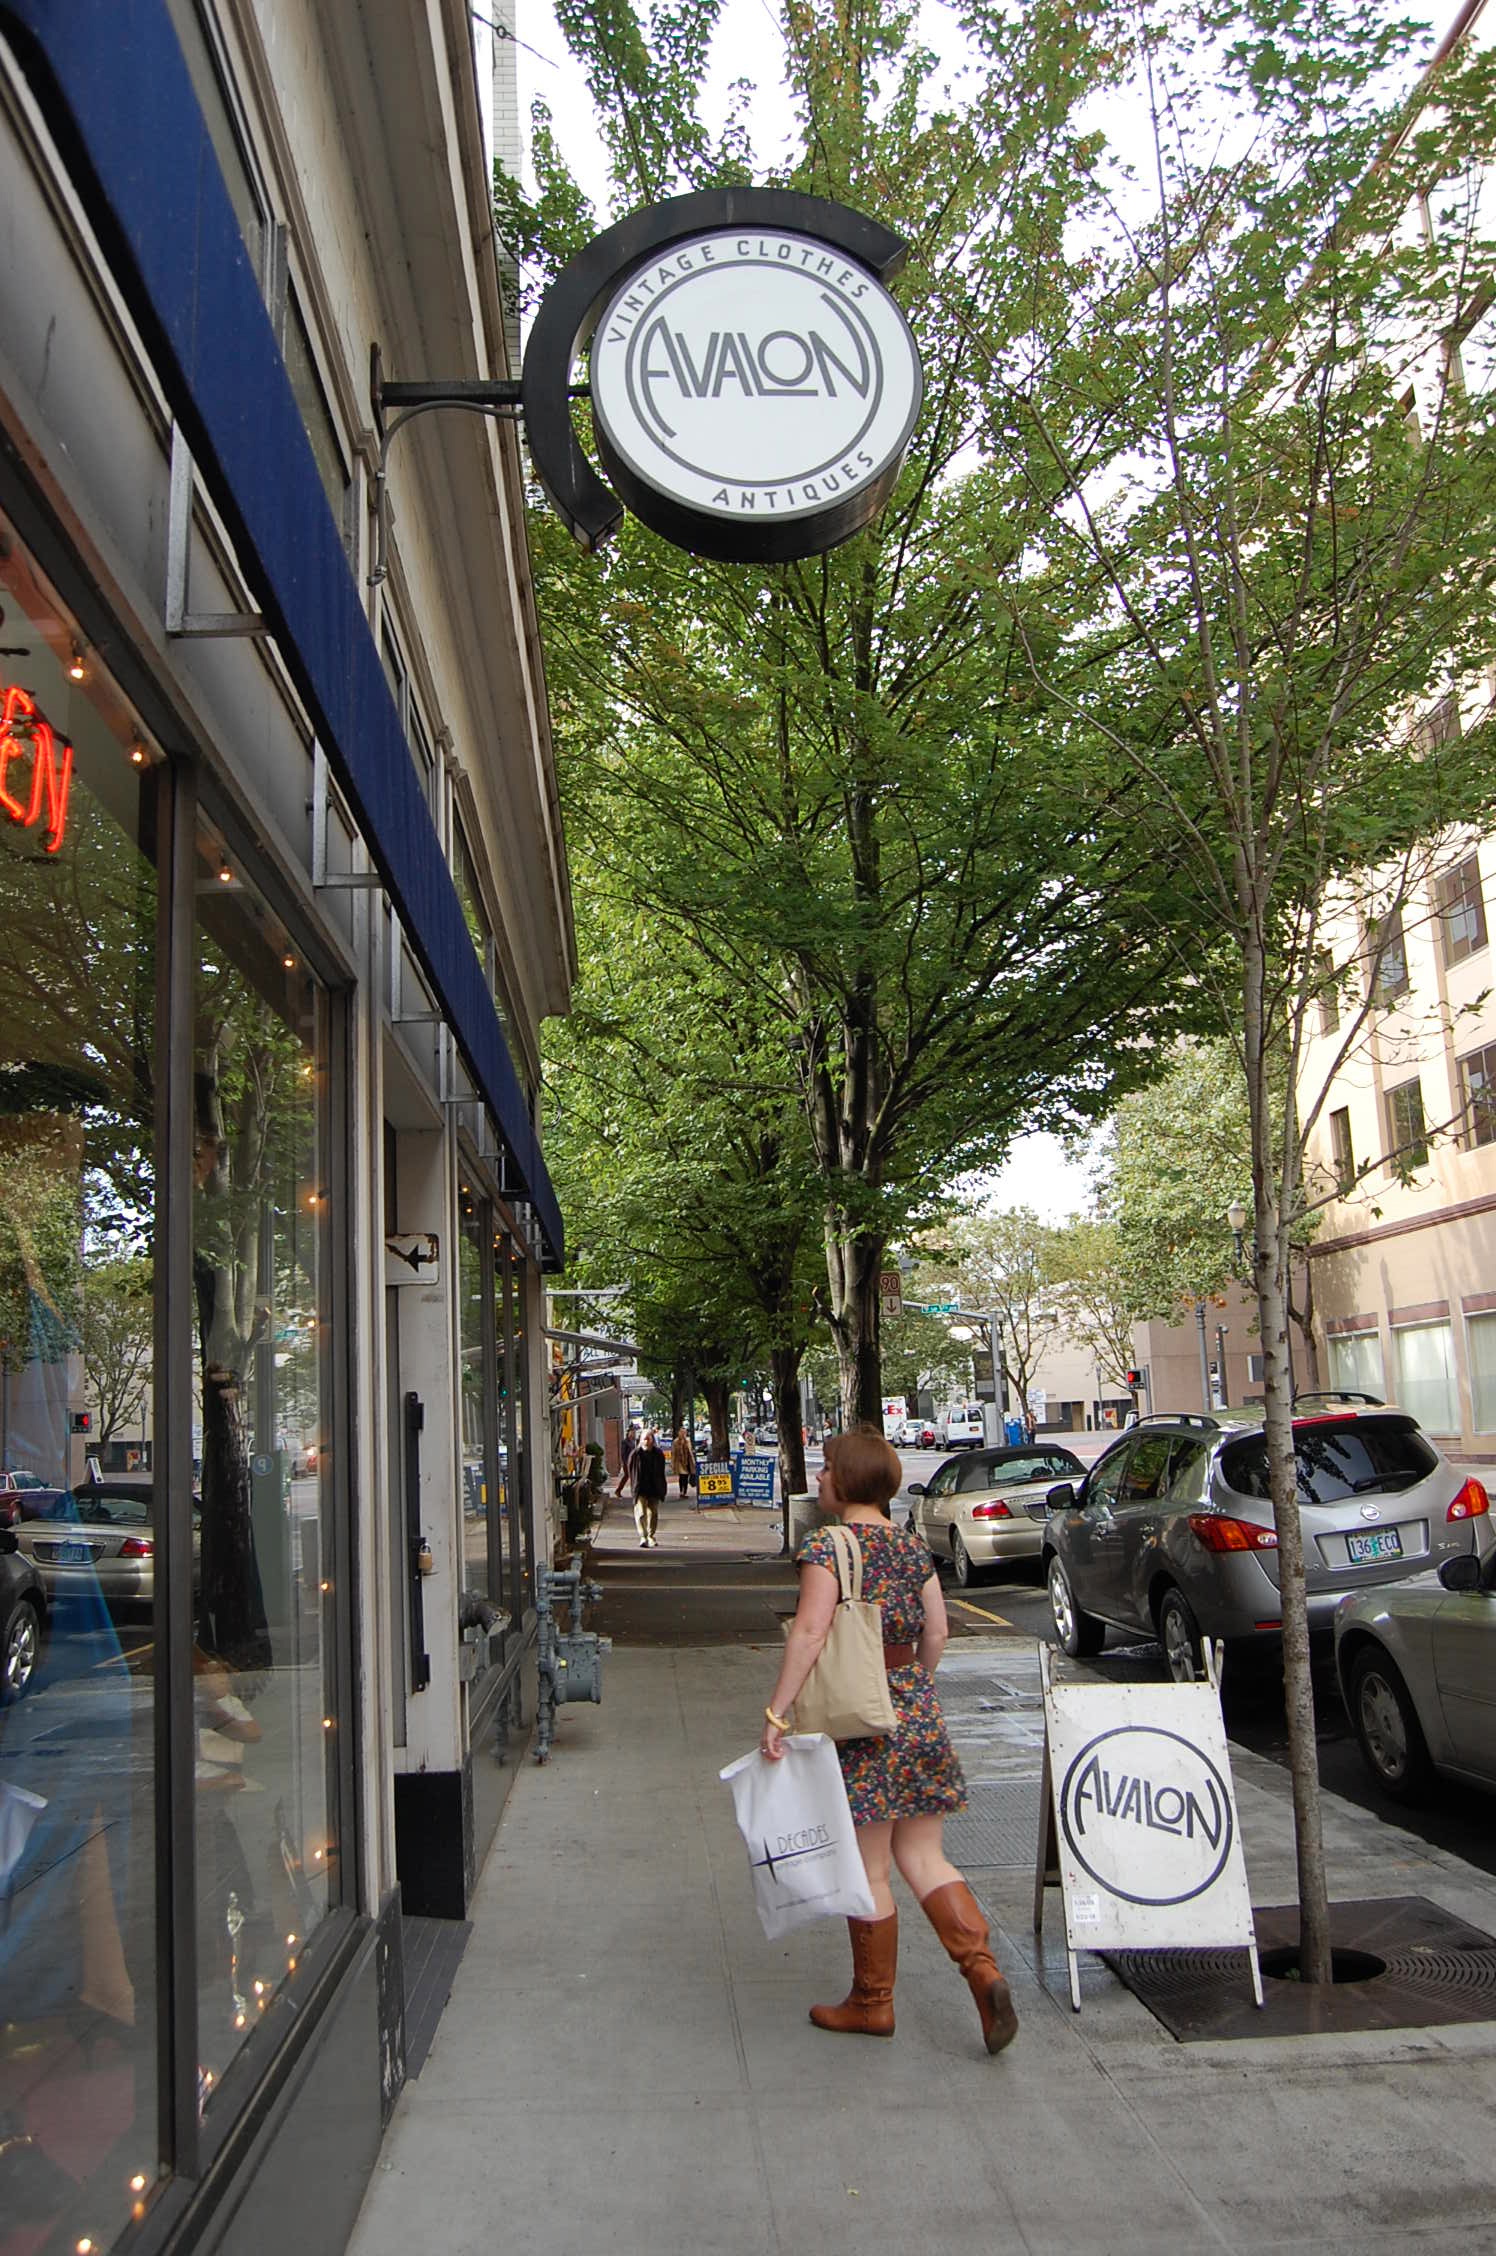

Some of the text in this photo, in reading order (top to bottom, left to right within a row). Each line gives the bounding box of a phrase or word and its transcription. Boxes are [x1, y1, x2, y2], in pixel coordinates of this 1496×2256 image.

[607, 239, 870, 344] VINTAGE CLOTHES
[640, 292, 870, 439] AVALON
[712, 451, 874, 509] ANTIQUES
[700, 1462, 729, 1474] SPECIAL
[741, 1458, 769, 1466] MONTHLY
[1074, 1754, 1222, 1851] AVALON
[777, 1824, 830, 1853] DECADES
